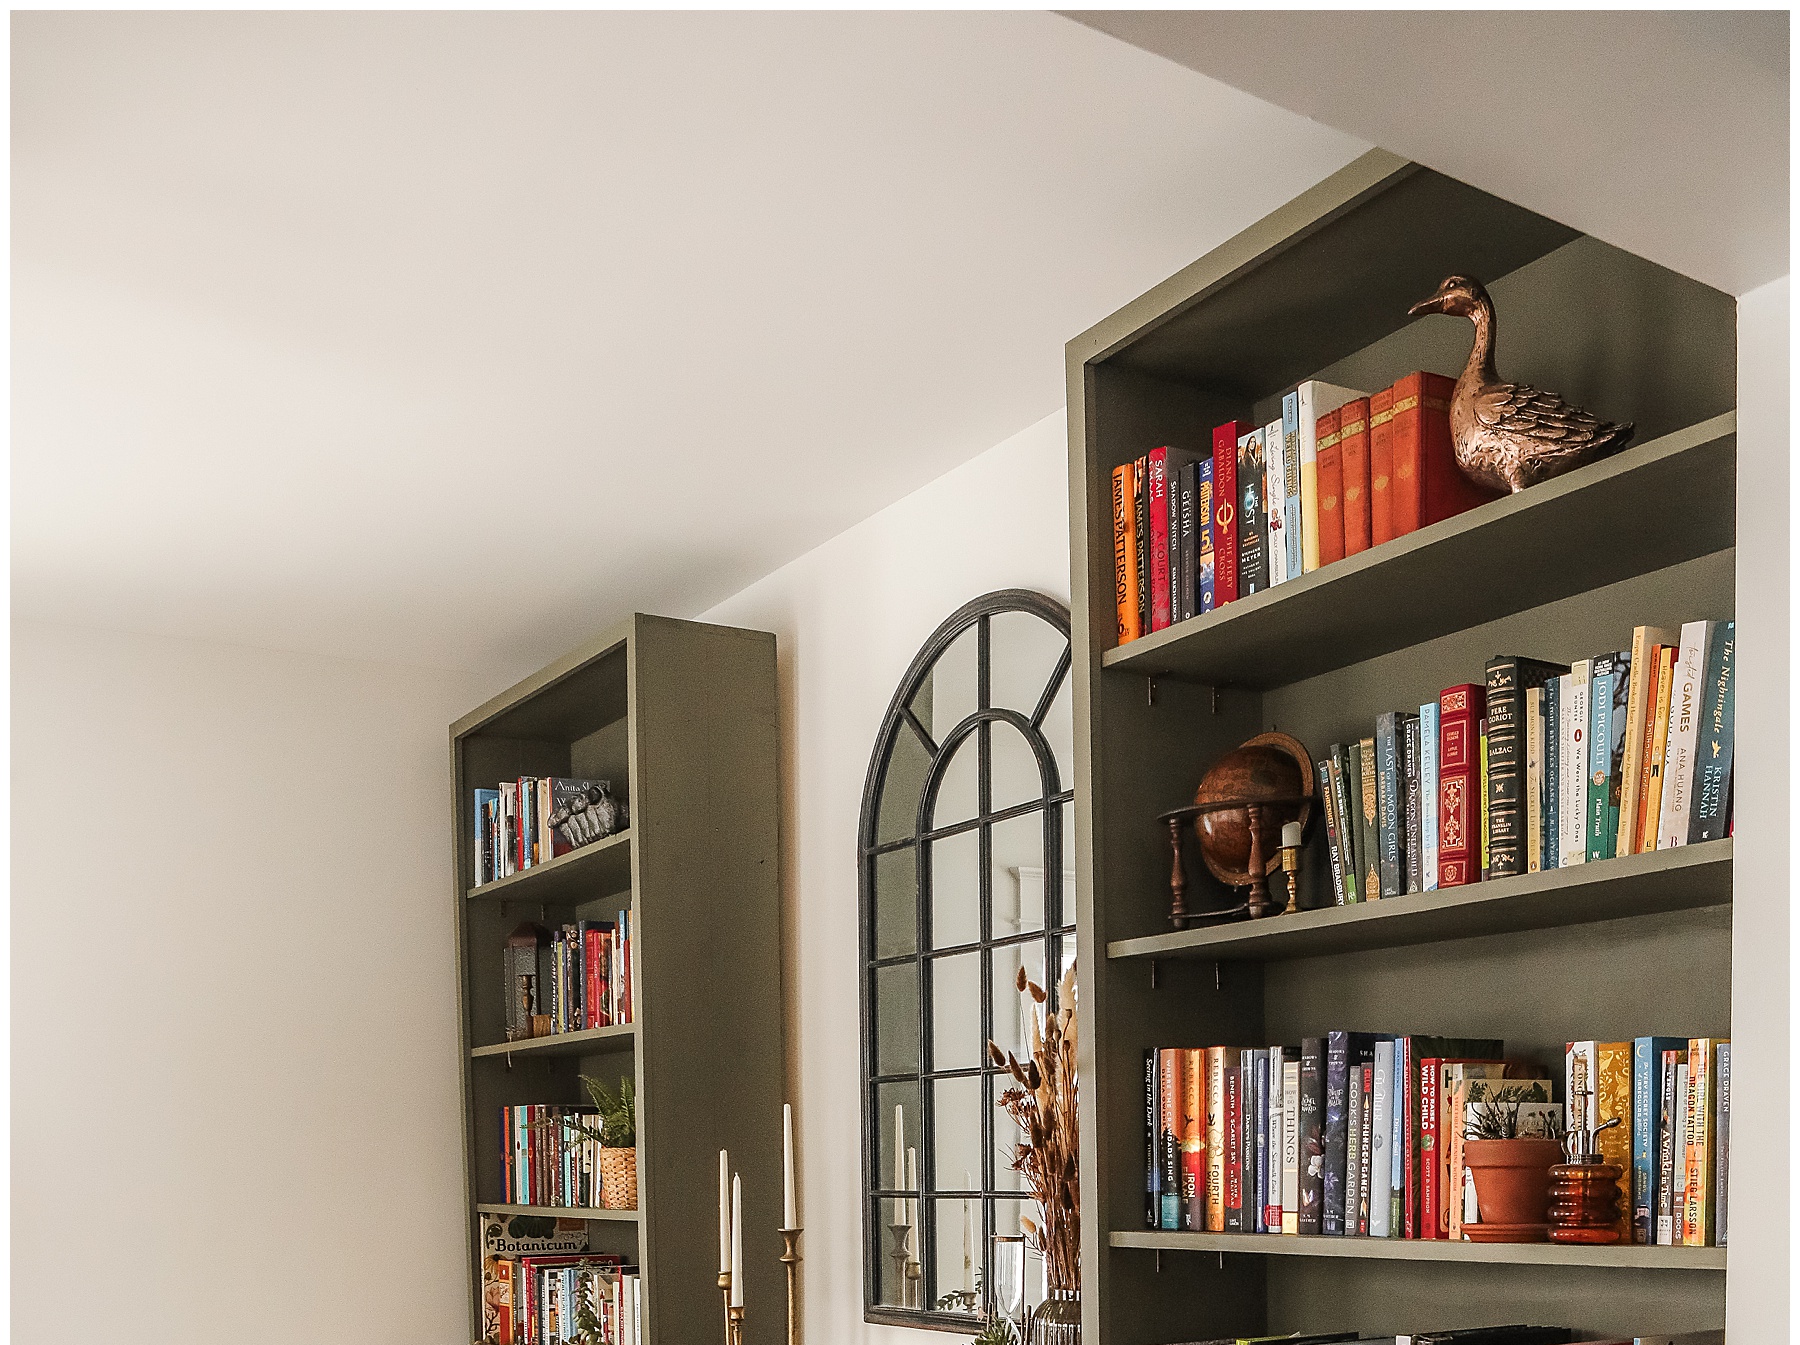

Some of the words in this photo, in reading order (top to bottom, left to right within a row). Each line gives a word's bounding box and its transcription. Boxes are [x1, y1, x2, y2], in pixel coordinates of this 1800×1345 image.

[1155, 460, 1163, 497] SARAH
[1218, 439, 1226, 497] GABALDON
[1113, 473, 1124, 518] JAMES
[1200, 480, 1209, 526] PATTERSON
[1244, 483, 1255, 525] HOST
[1136, 499, 1144, 538] JAMES
[1182, 490, 1190, 538] GEISHA
[1115, 519, 1127, 605] PATTERSON
[1157, 542, 1165, 581] COURT
[1241, 552, 1261, 563] MEYER
[1137, 541, 1145, 614] PATTERSON
[1723, 640, 1734, 661] The
[1596, 680, 1607, 711] JODI
[1679, 682, 1693, 732] GAMES
[1713, 665, 1730, 733] Nightingale
[1488, 713, 1513, 724] GORIOT
[1488, 746, 1513, 757] BALZAC
[1595, 713, 1606, 767] PICOULT
[1385, 748, 1394, 772] LAST
[1678, 748, 1687, 770] ANA
[554, 780, 580, 792] Anita
[1674, 774, 1685, 812] HUANG
[1700, 766, 1713, 819] HANNAH
[1710, 767, 1723, 818] KRISTIN
[1387, 794, 1395, 830] MOON
[1331, 845, 1339, 864] RAY
[1387, 833, 1396, 862] GIRLS
[1334, 864, 1344, 906] BRADBURY
[1350, 1082, 1358, 1125] COOK'S
[1687, 1076, 1695, 1112] DRAGON
[1687, 1115, 1695, 1146] TATTOO
[1697, 1105, 1705, 1128] WITH
[1286, 1108, 1295, 1164] THINGS
[1348, 1127, 1357, 1159] HERB
[1662, 1130, 1670, 1140] A
[1696, 1131, 1704, 1146] THE
[1661, 1140, 1672, 1176] Wrinkle
[1187, 1173, 1195, 1198] IRON
[1346, 1162, 1356, 1215] GARDEN
[1690, 1167, 1698, 1193] STIEG
[1688, 1195, 1697, 1235] LARSSON
[495, 1239, 577, 1251] Botanicum
